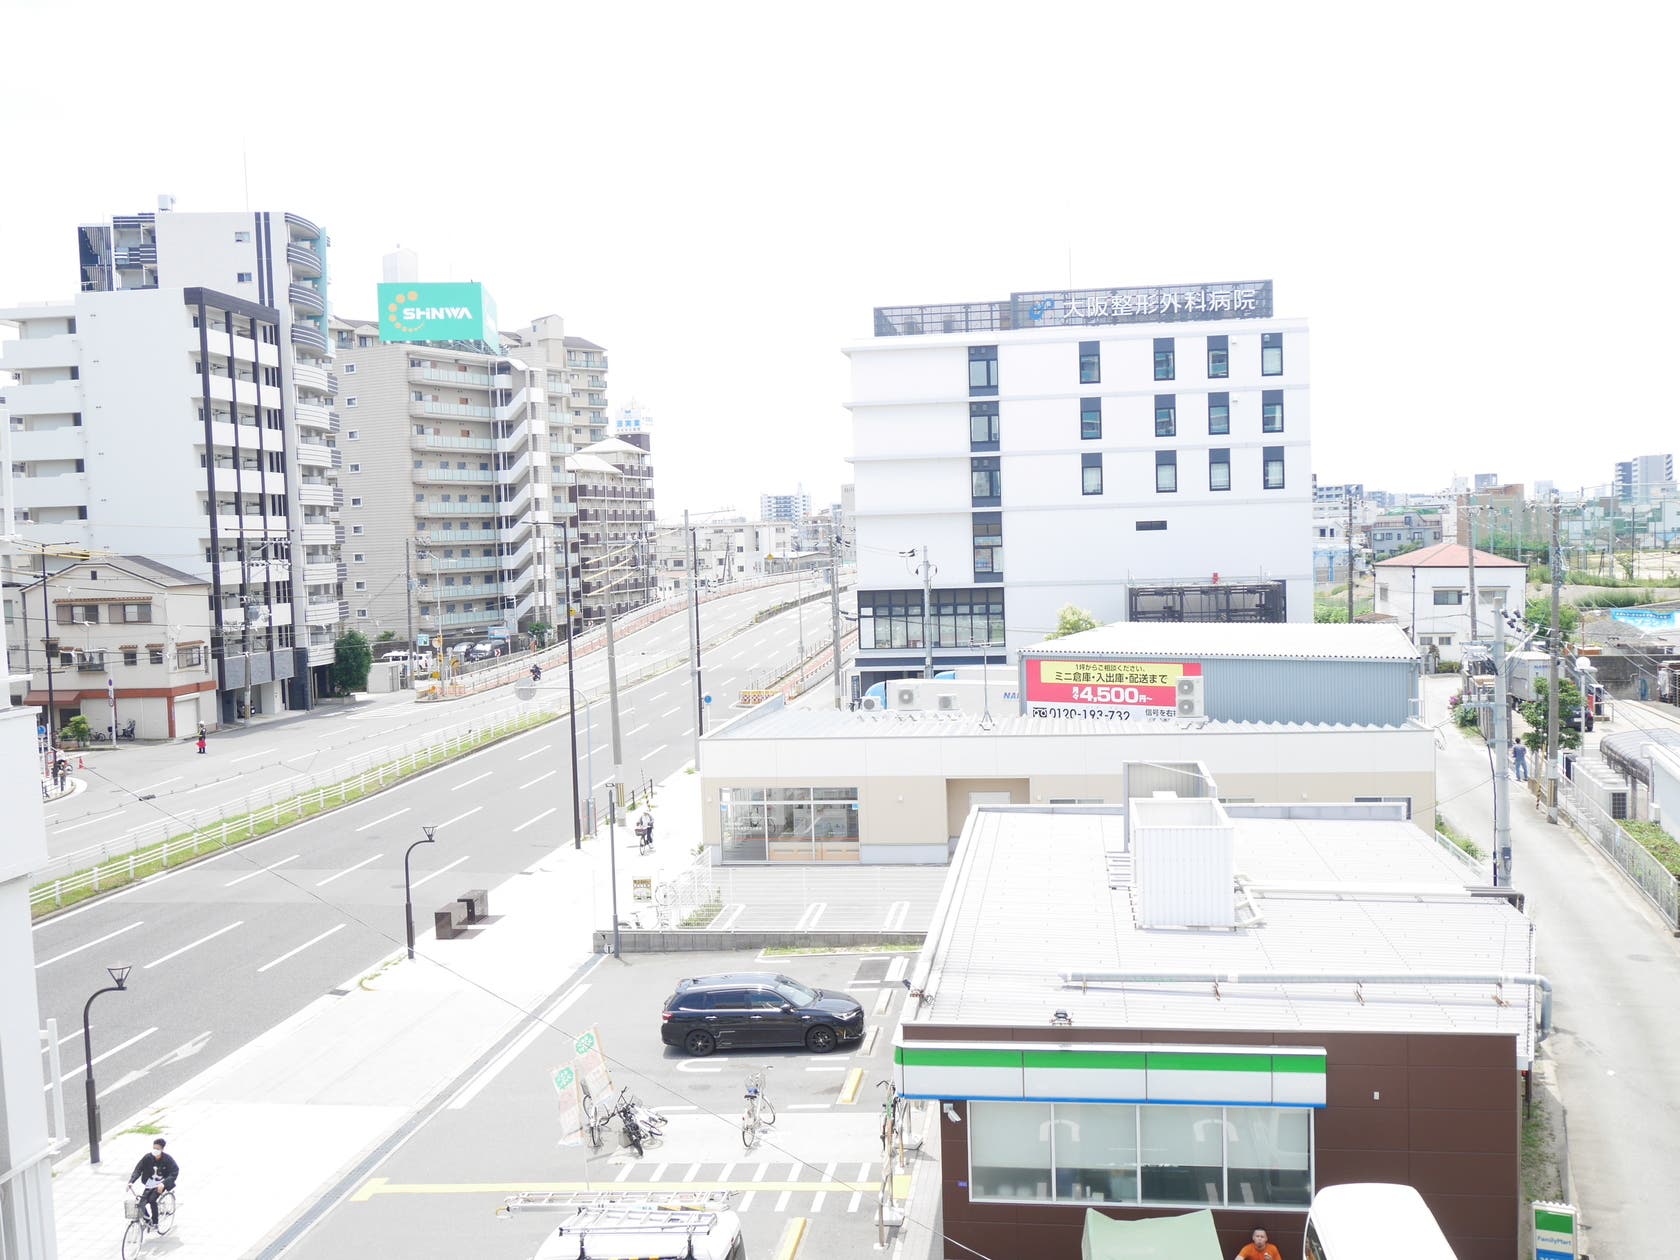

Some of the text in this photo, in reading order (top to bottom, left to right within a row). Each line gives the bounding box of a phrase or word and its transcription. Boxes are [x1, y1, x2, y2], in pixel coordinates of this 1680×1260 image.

[402, 307, 473, 320] SHINWA
[1062, 289, 1256, 319] 大阪整形外科病院
